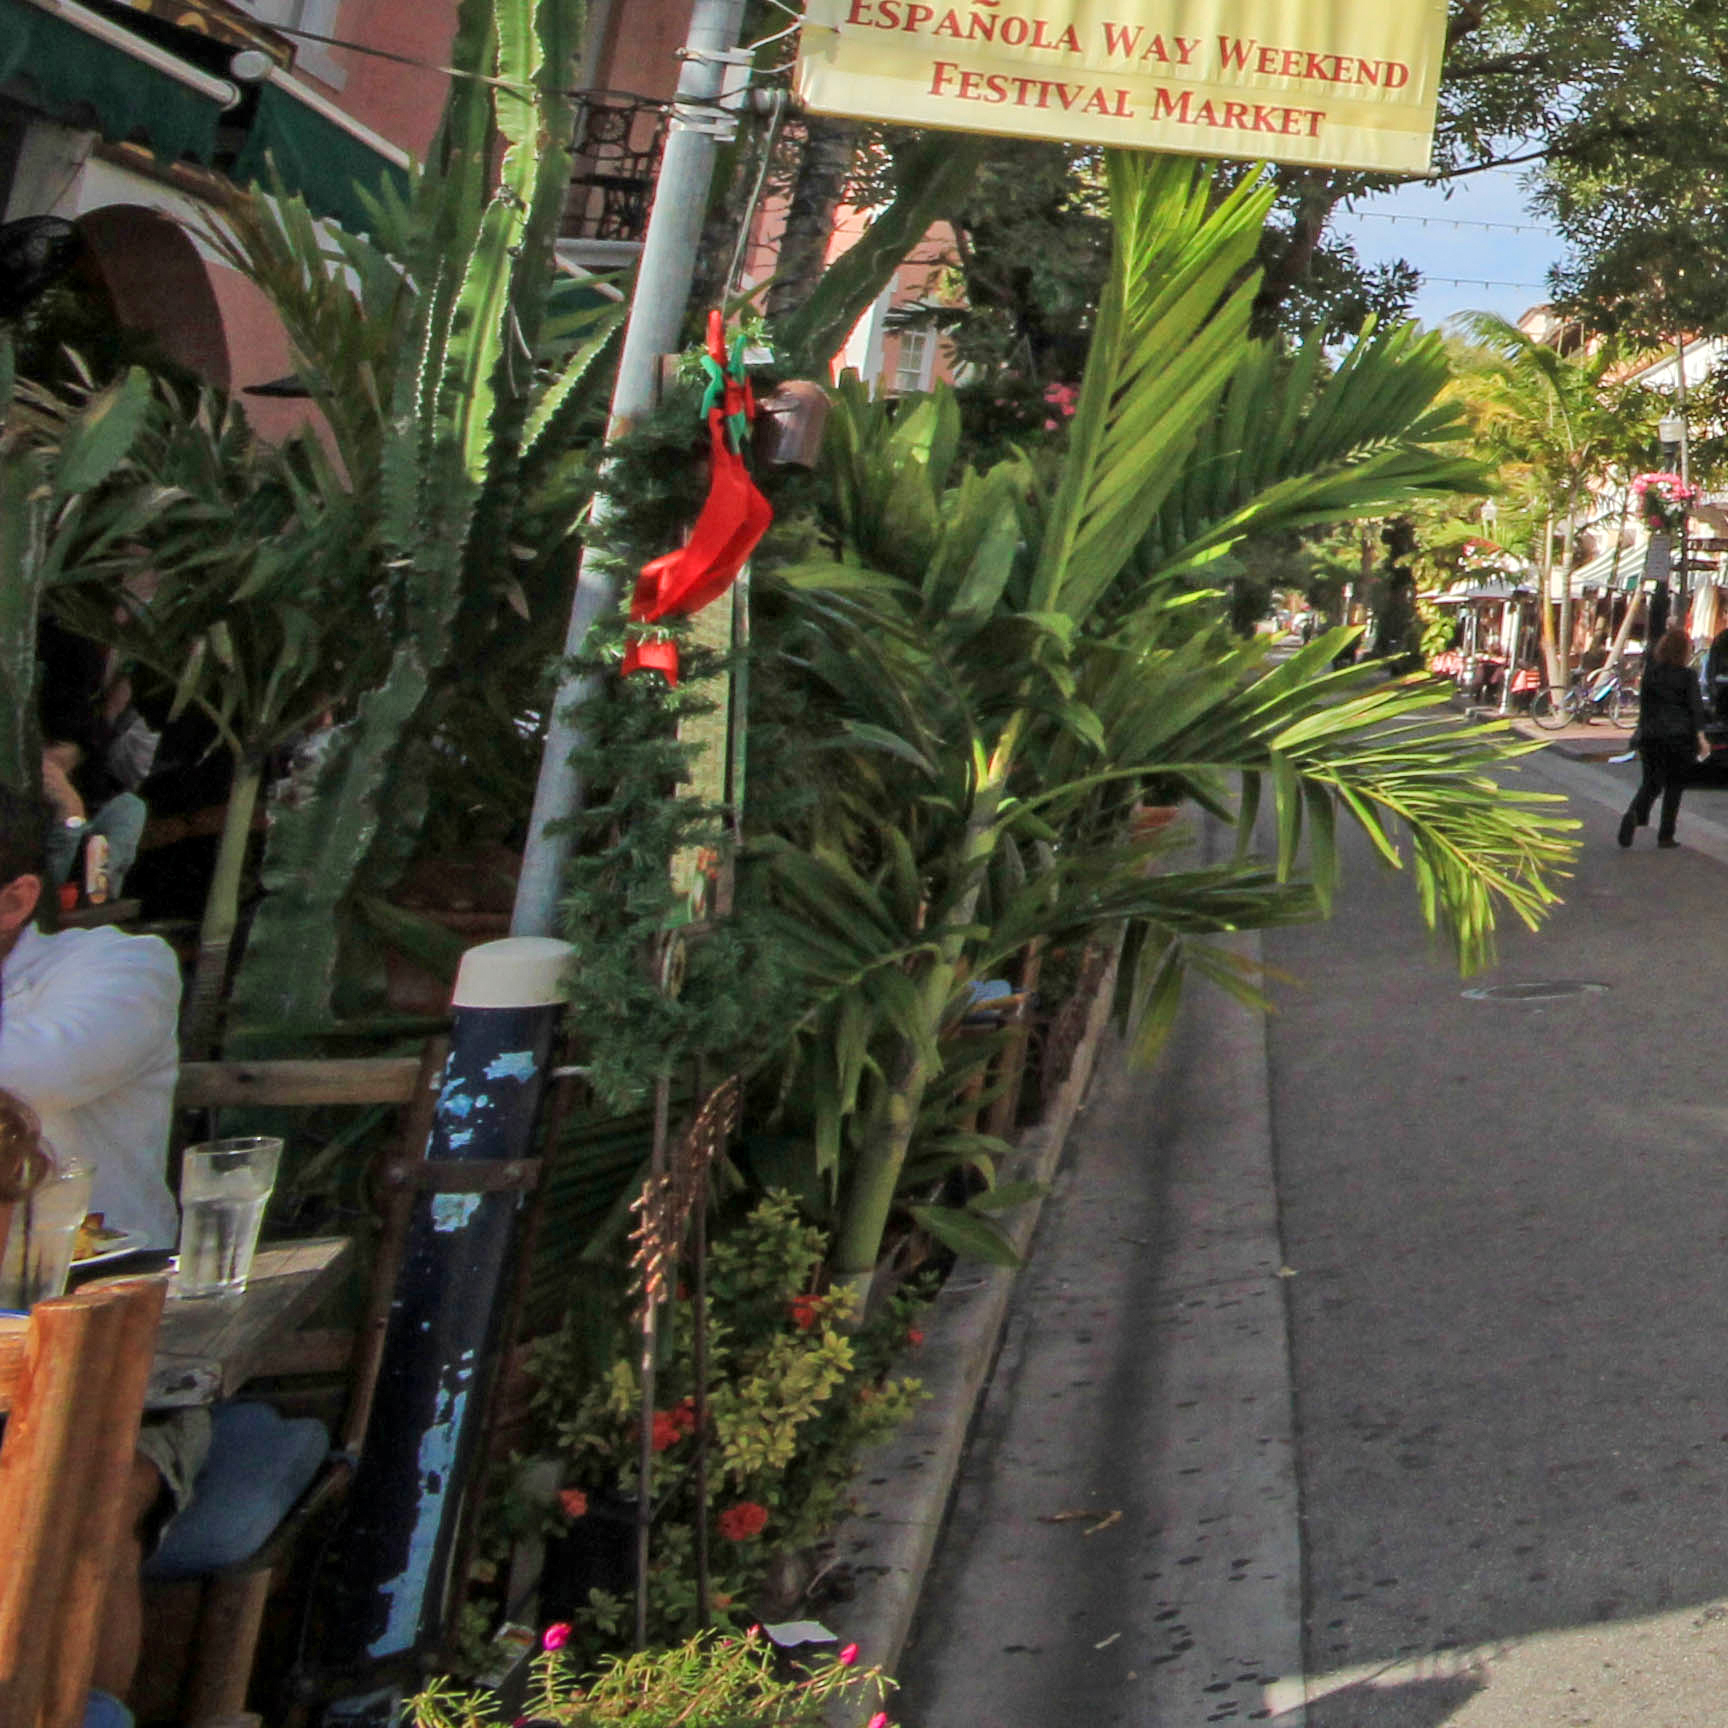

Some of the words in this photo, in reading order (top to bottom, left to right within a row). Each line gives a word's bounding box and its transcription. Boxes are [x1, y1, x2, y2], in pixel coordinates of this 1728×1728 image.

[1101, 22, 1202, 65] WAY
[1217, 35, 1409, 88] WEEKEND
[928, 62, 1133, 118] FESTIVAL
[1150, 86, 1326, 138] MARKET
